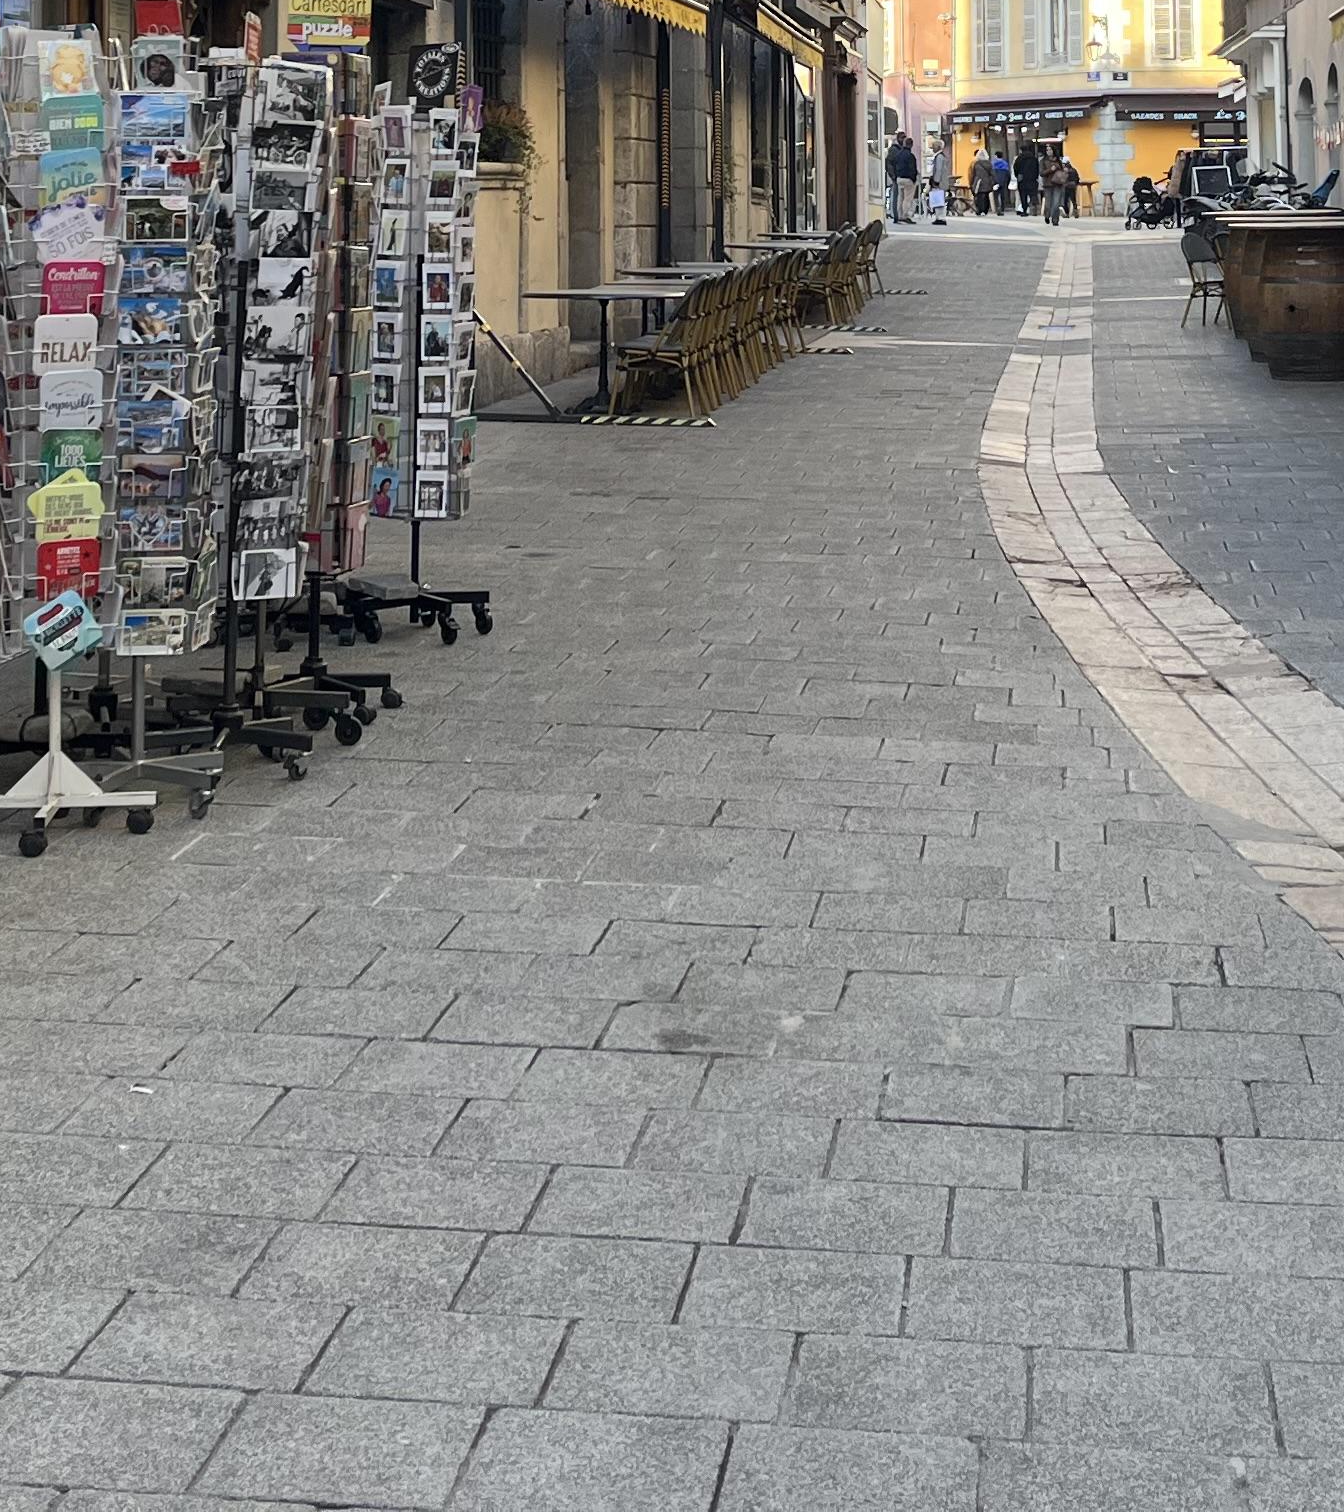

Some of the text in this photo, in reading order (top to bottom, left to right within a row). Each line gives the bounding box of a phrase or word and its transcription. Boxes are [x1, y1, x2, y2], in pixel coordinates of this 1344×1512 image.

[301, 21, 354, 43] puzzle
[48, 171, 97, 203] jolie
[40, 341, 93, 364] RELAX
